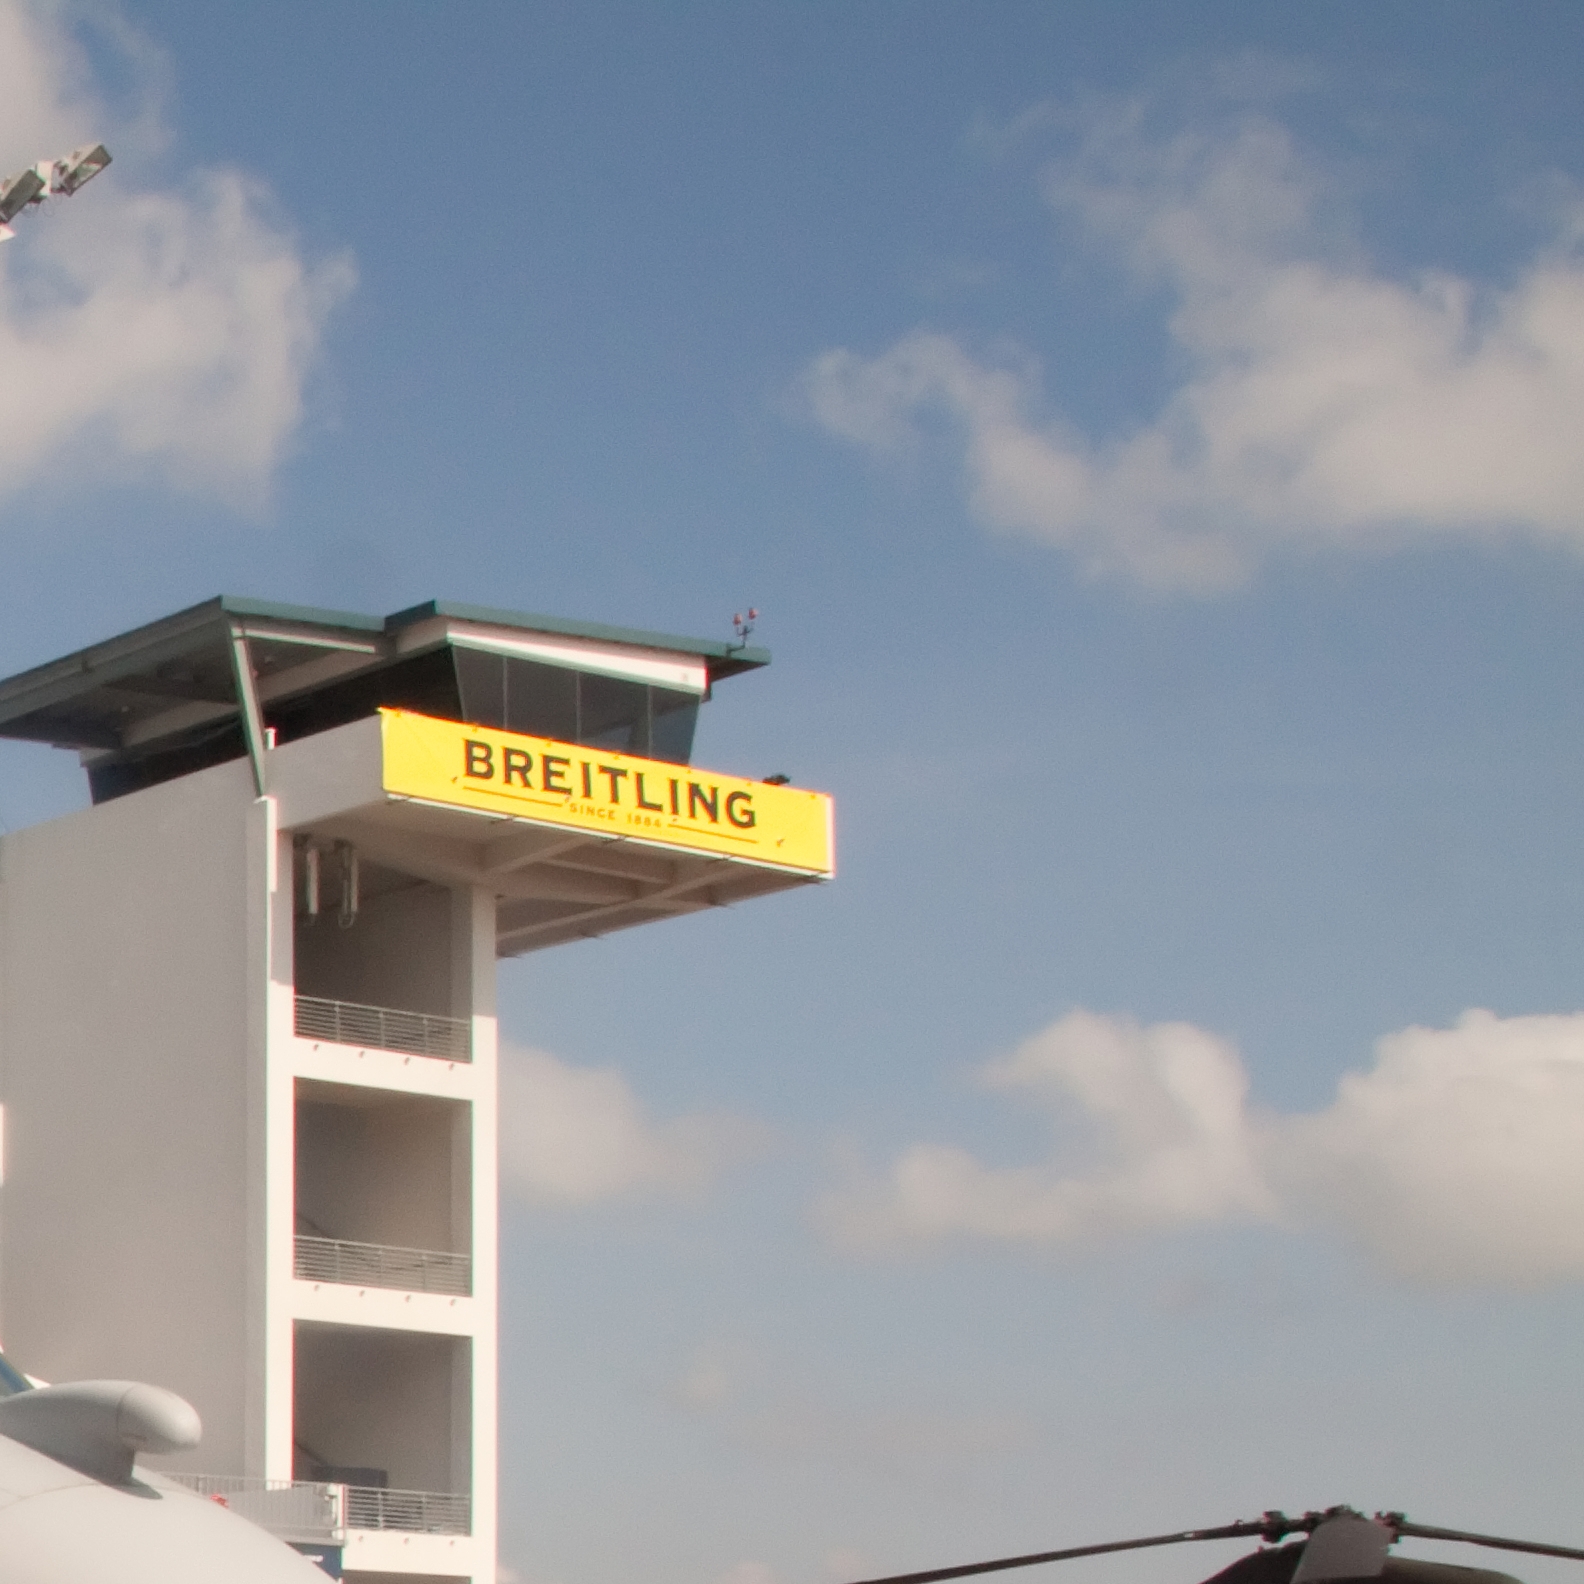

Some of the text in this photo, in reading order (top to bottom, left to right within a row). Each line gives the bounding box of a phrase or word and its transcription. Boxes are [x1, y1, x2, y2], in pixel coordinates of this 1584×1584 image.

[463, 738, 757, 830] BREITLING
[569, 802, 662, 828] SINCE 1884
